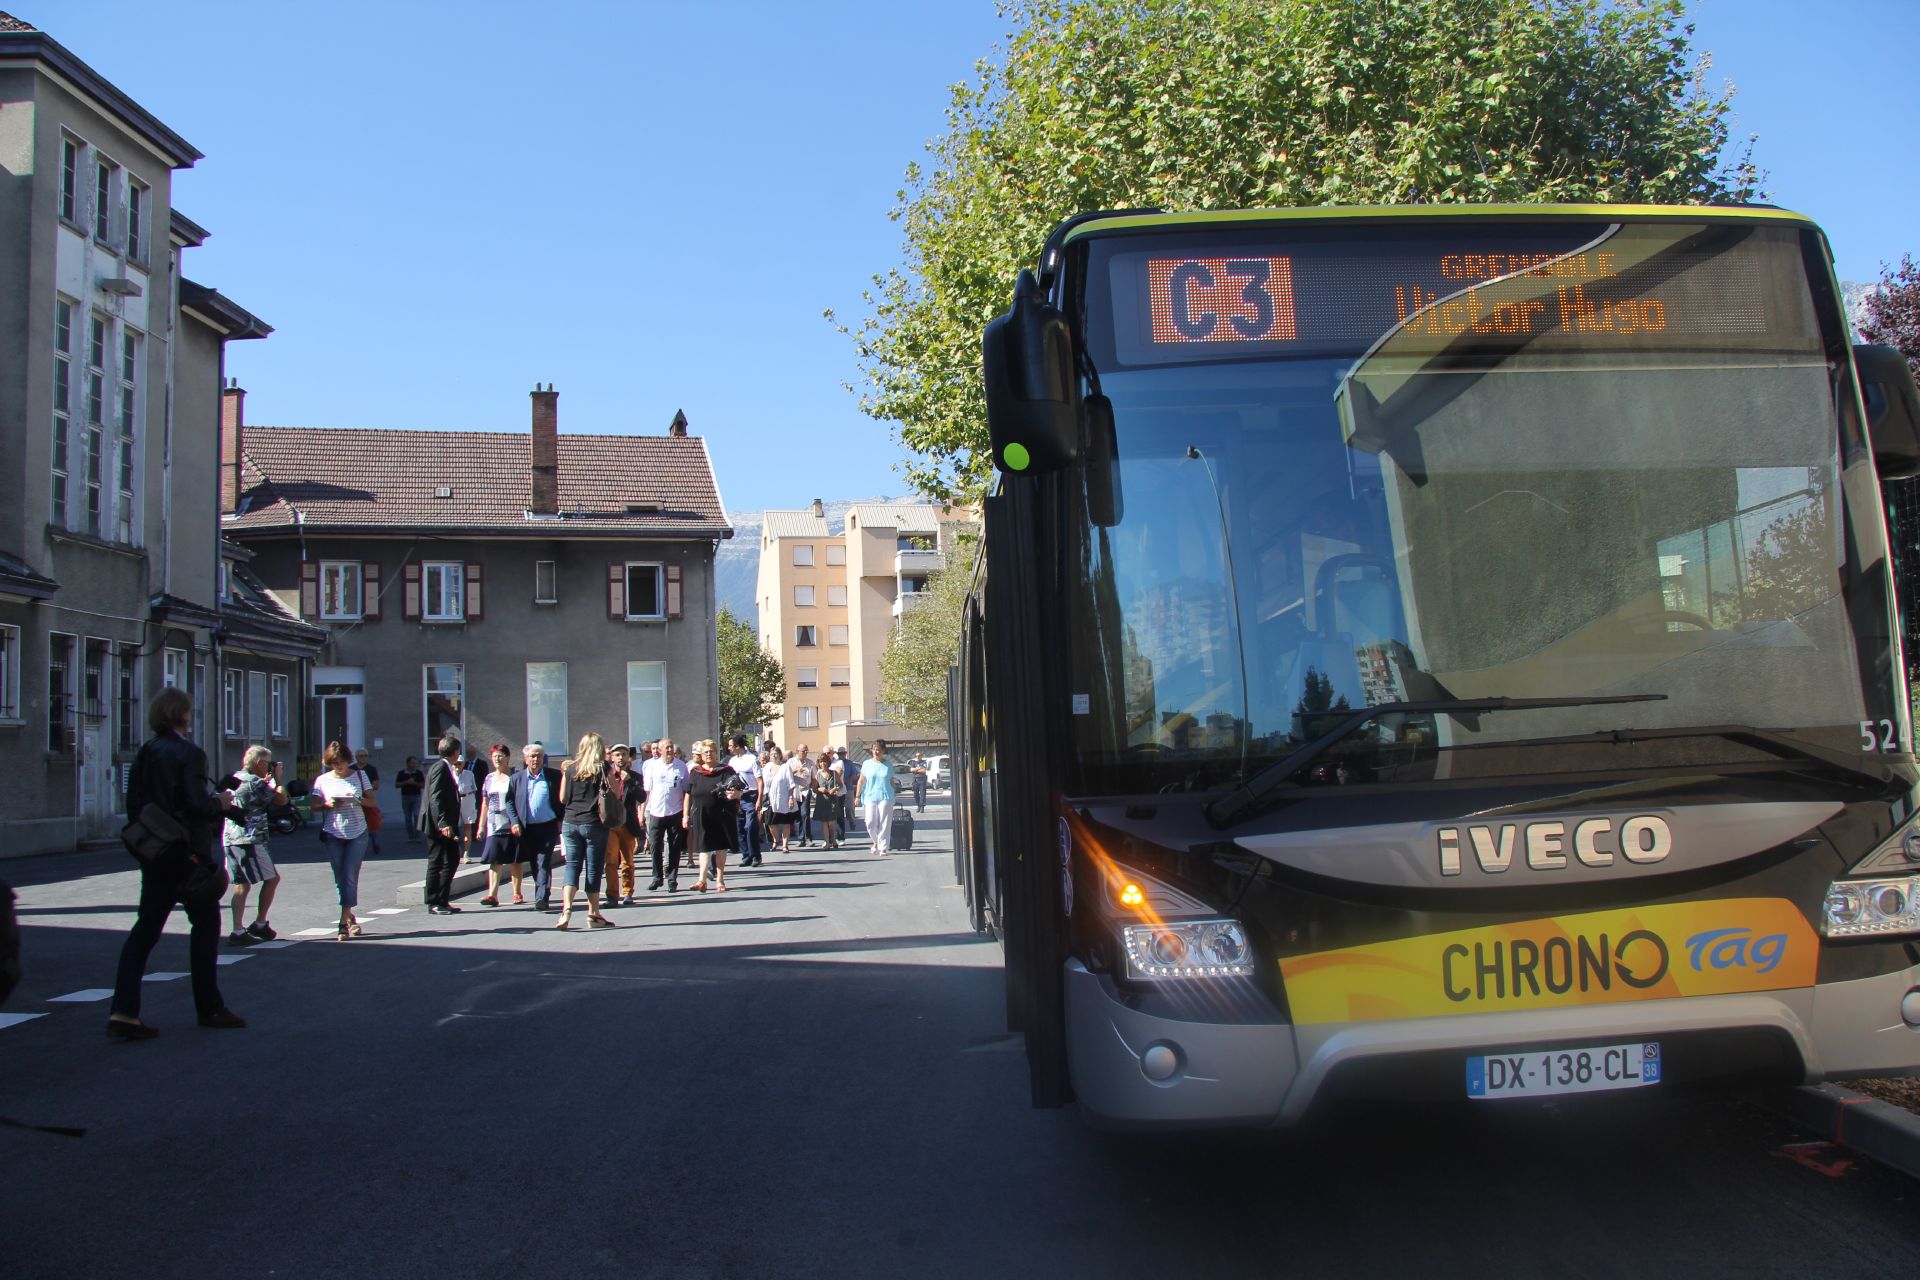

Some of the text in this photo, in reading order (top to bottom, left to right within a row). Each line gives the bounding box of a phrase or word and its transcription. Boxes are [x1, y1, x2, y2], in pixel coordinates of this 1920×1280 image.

[1441, 254, 1617, 279] GRENOBLE
[1168, 259, 1275, 341] C3
[1395, 284, 1666, 334] Victor Hugo
[1442, 928, 1788, 1002] CHRONO Tag
[1488, 1049, 1639, 1090] DX-138-CL
[1643, 1063, 1658, 1078] 38
